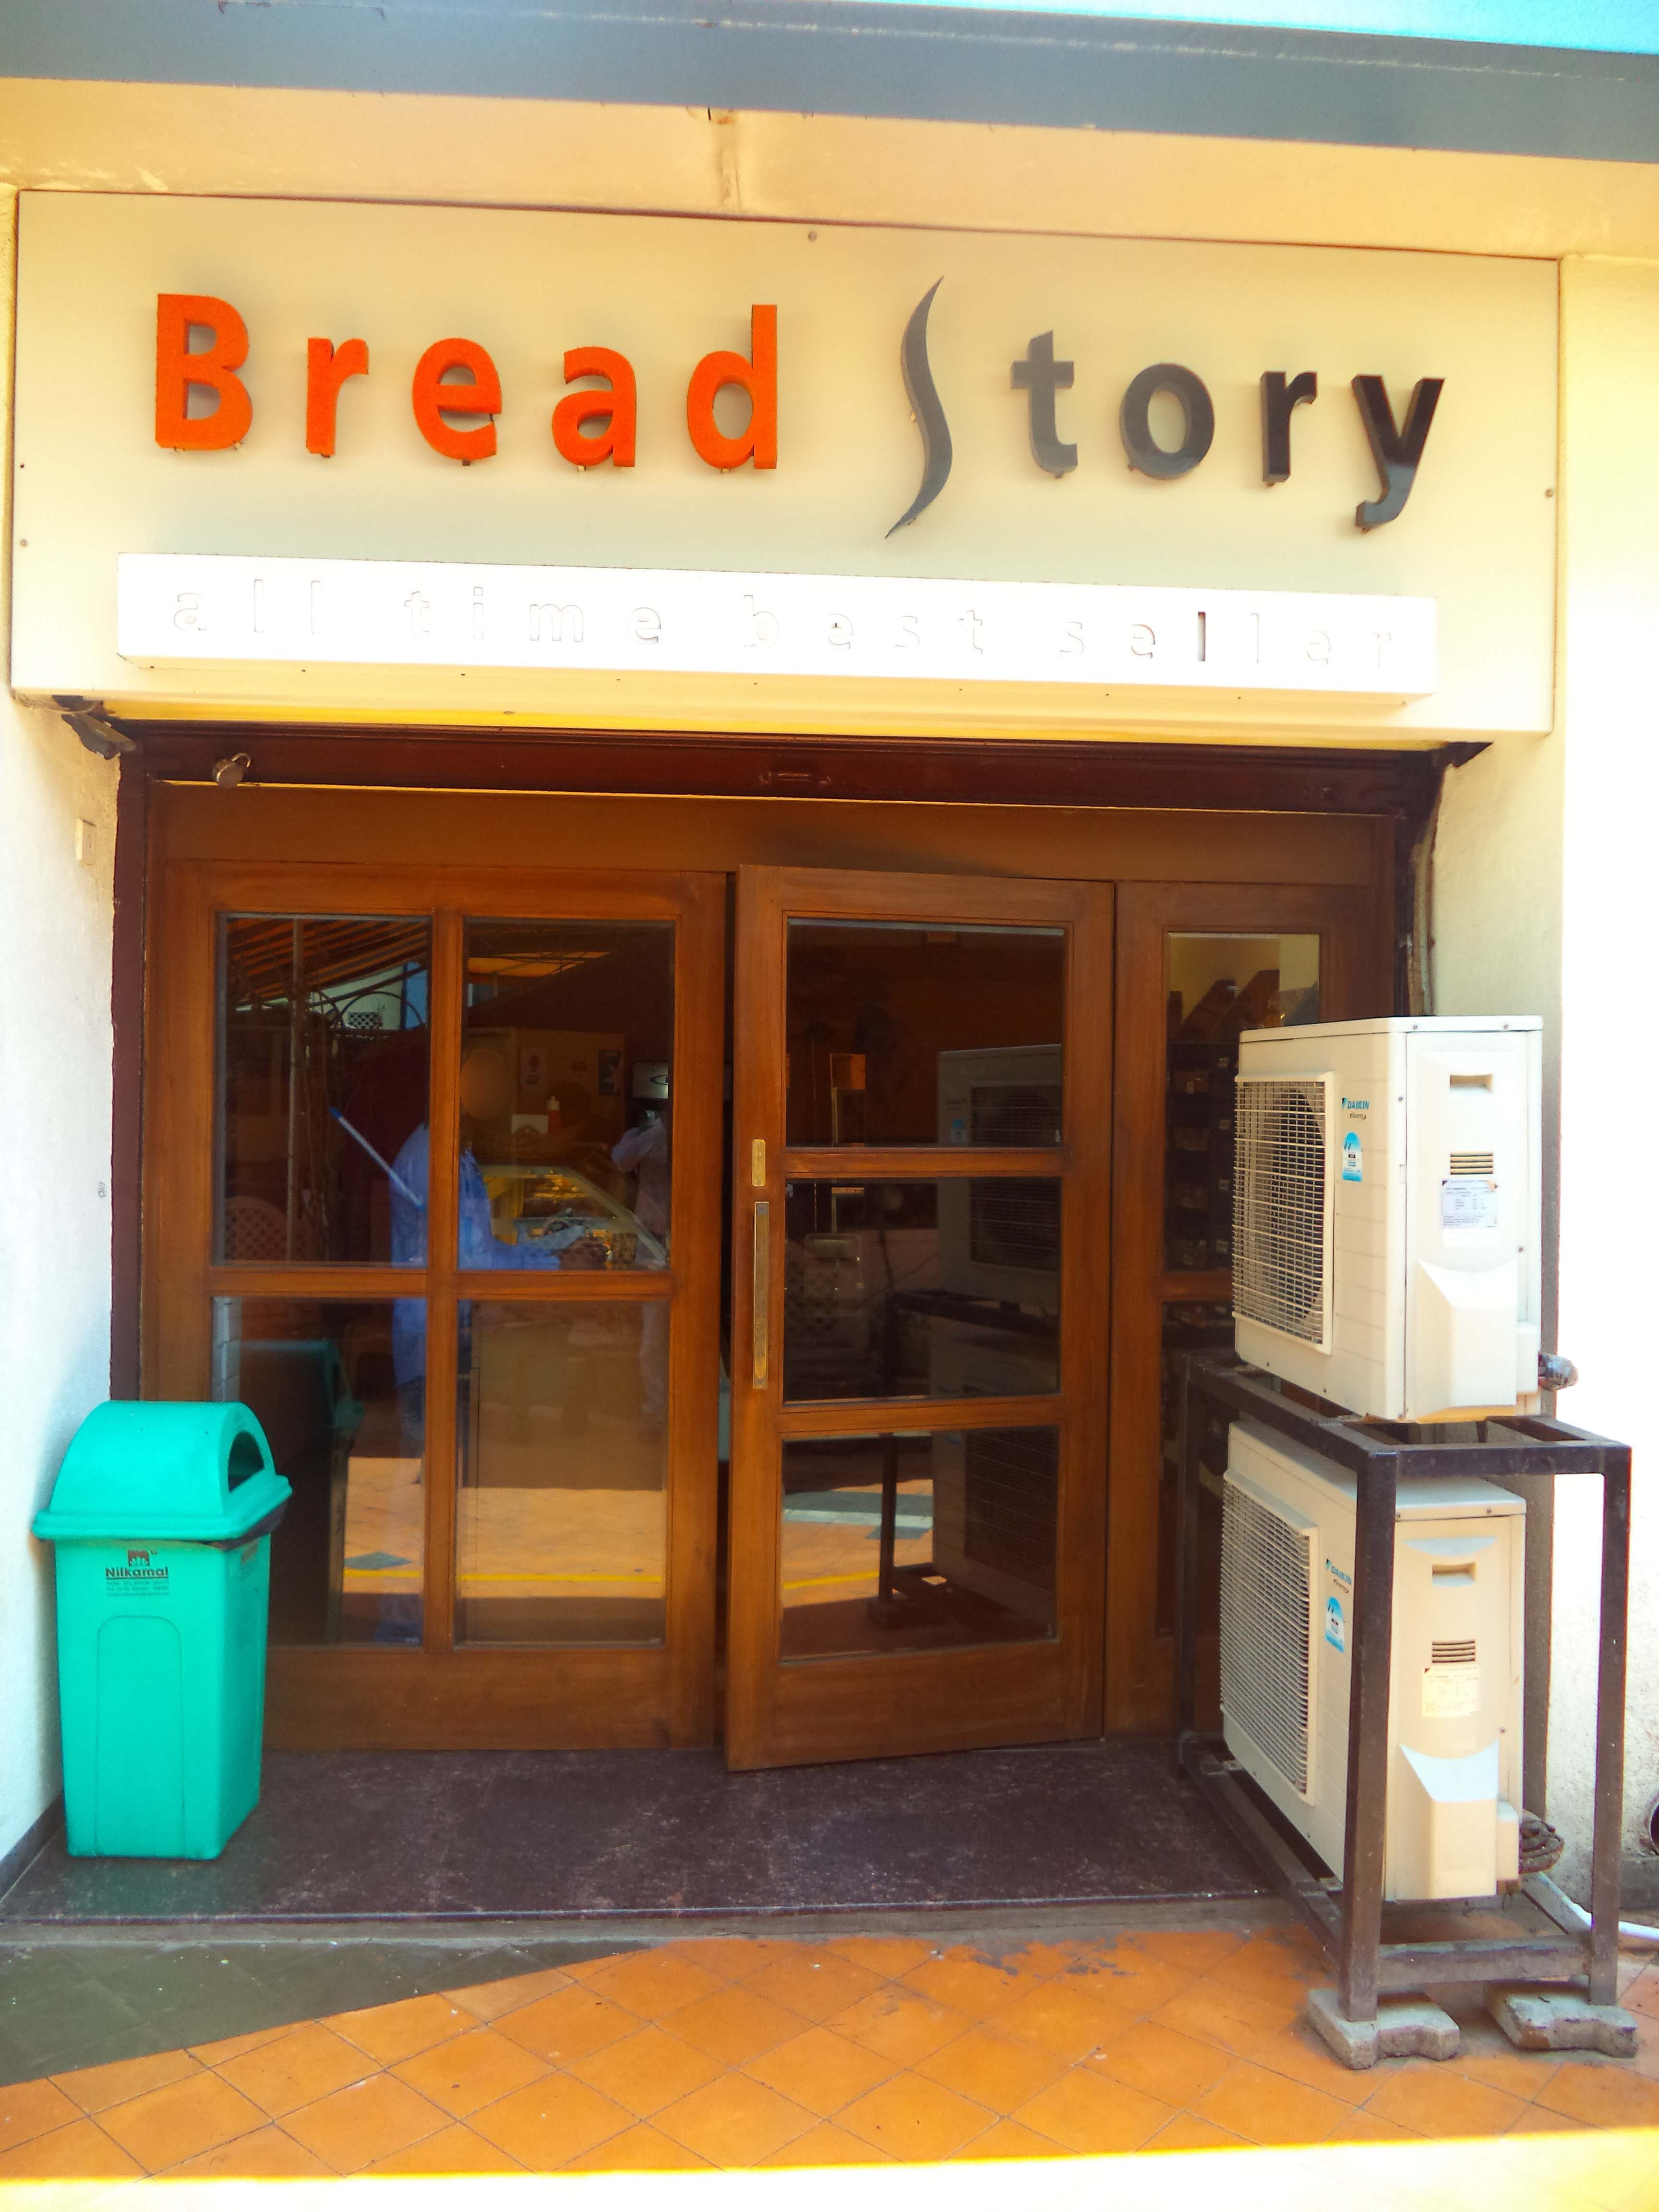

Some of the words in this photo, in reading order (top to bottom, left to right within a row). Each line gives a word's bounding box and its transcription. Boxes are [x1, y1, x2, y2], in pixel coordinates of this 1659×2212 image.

[155, 293, 778, 472] Bread
[885, 276, 1446, 540] Story
[173, 577, 323, 635] all
[404, 586, 662, 645] time
[742, 594, 984, 656] best
[1057, 610, 1393, 668] seller
[1347, 1100, 1370, 1109] DAIKIN
[105, 1566, 169, 1577] Nilkamal
